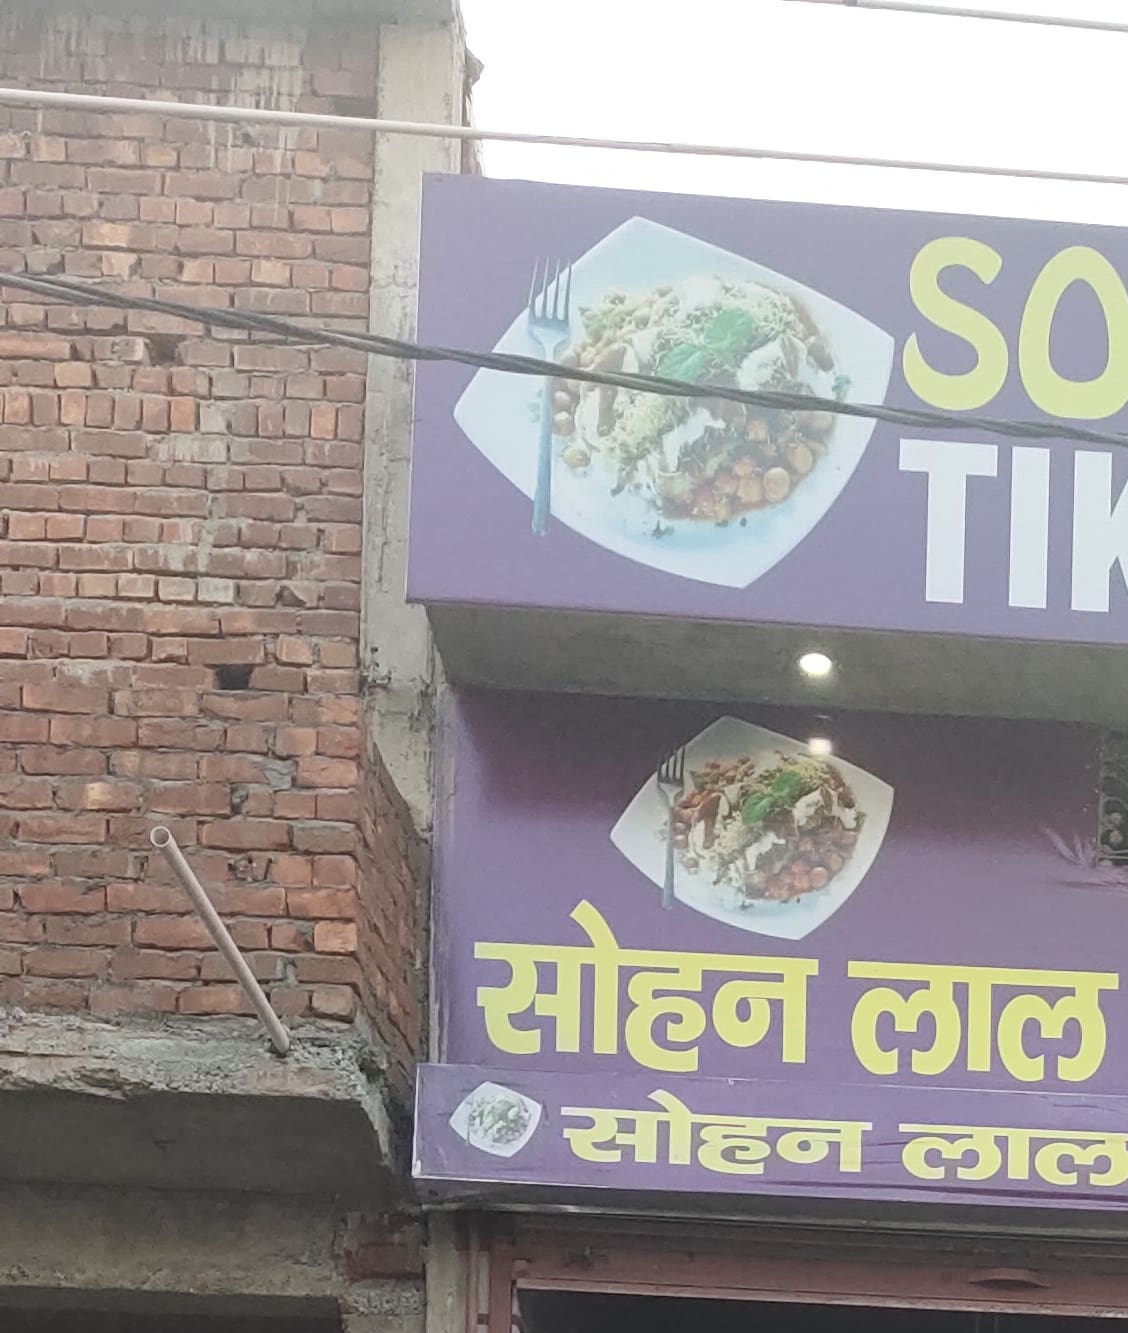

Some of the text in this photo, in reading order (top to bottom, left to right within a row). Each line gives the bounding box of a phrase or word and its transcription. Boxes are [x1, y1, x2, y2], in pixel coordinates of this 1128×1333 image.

[475, 900, 820, 1073] सोहन
[846, 959, 1121, 1083] लाल
[562, 1090, 873, 1175] सोहन
